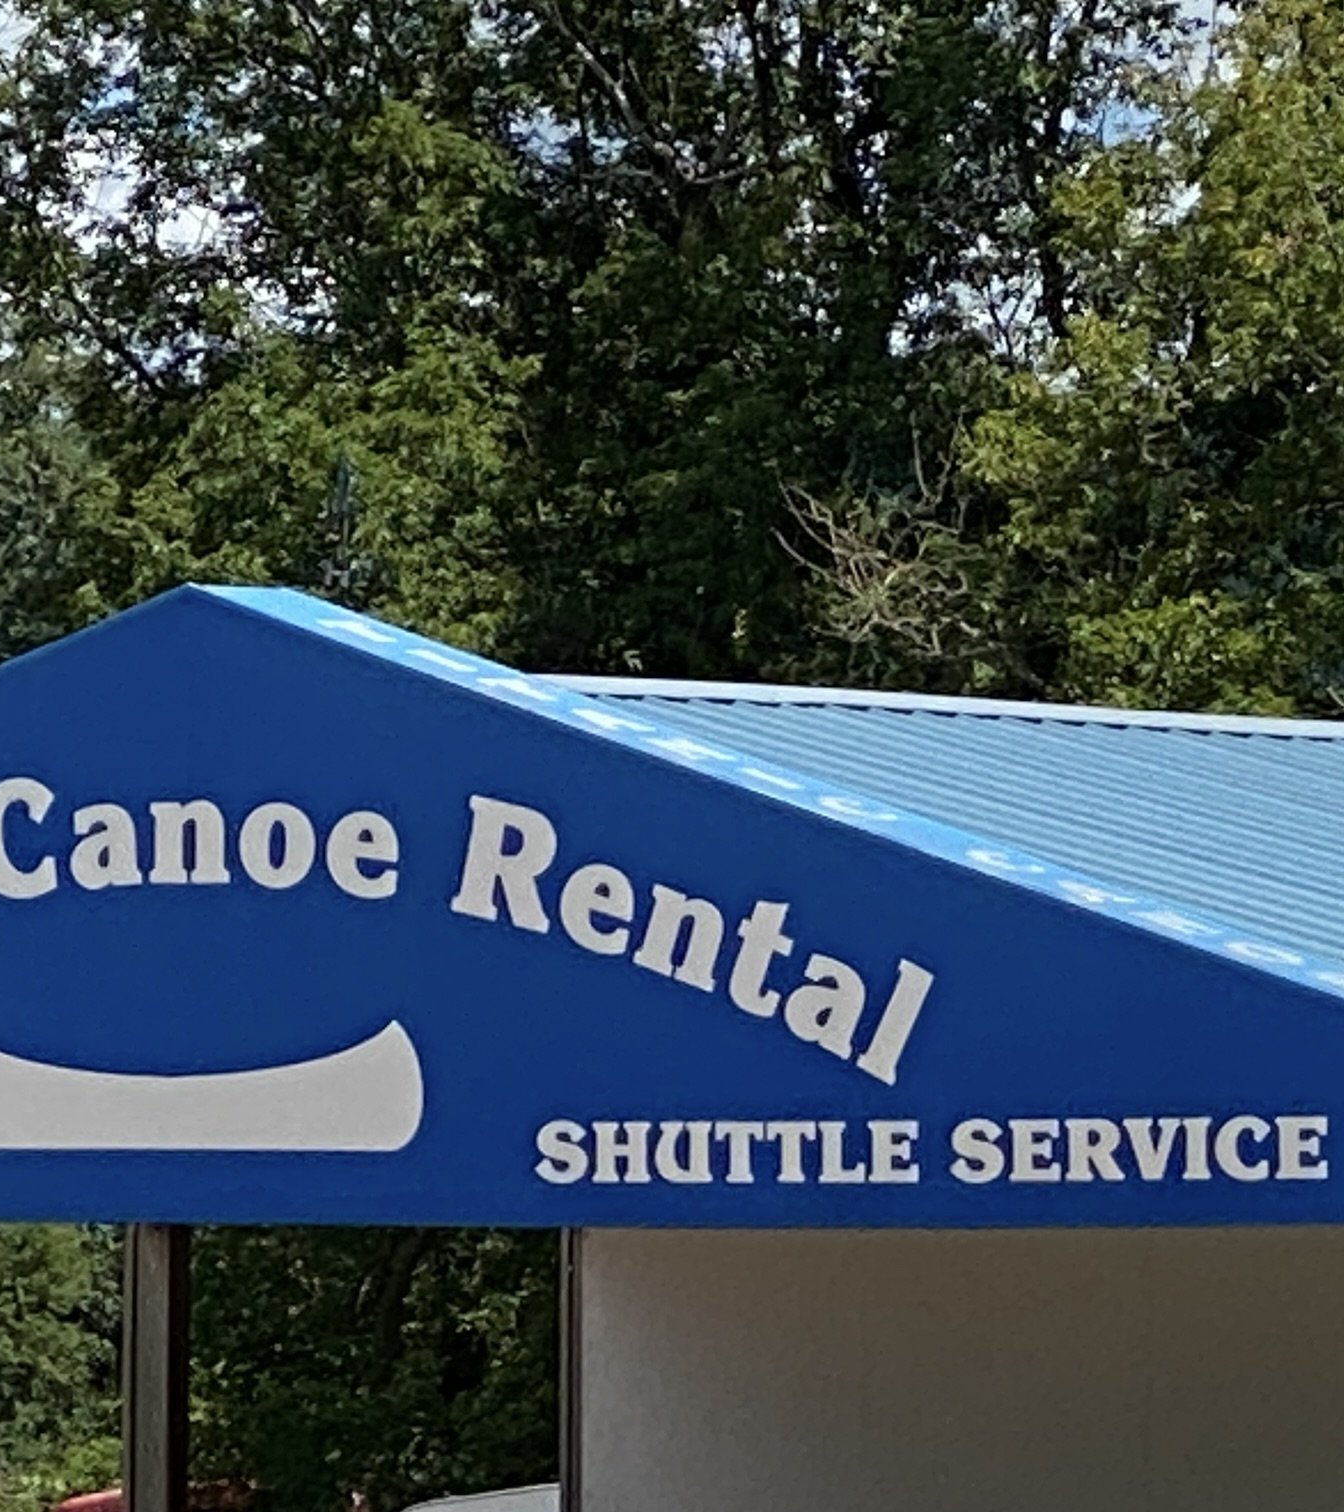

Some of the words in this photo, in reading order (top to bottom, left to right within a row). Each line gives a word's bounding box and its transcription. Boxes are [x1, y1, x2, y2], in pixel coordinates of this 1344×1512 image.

[450, 794, 934, 1086] Rental
[535, 1119, 920, 1184] SHUTTLE
[950, 1115, 1328, 1184] SERVICE
